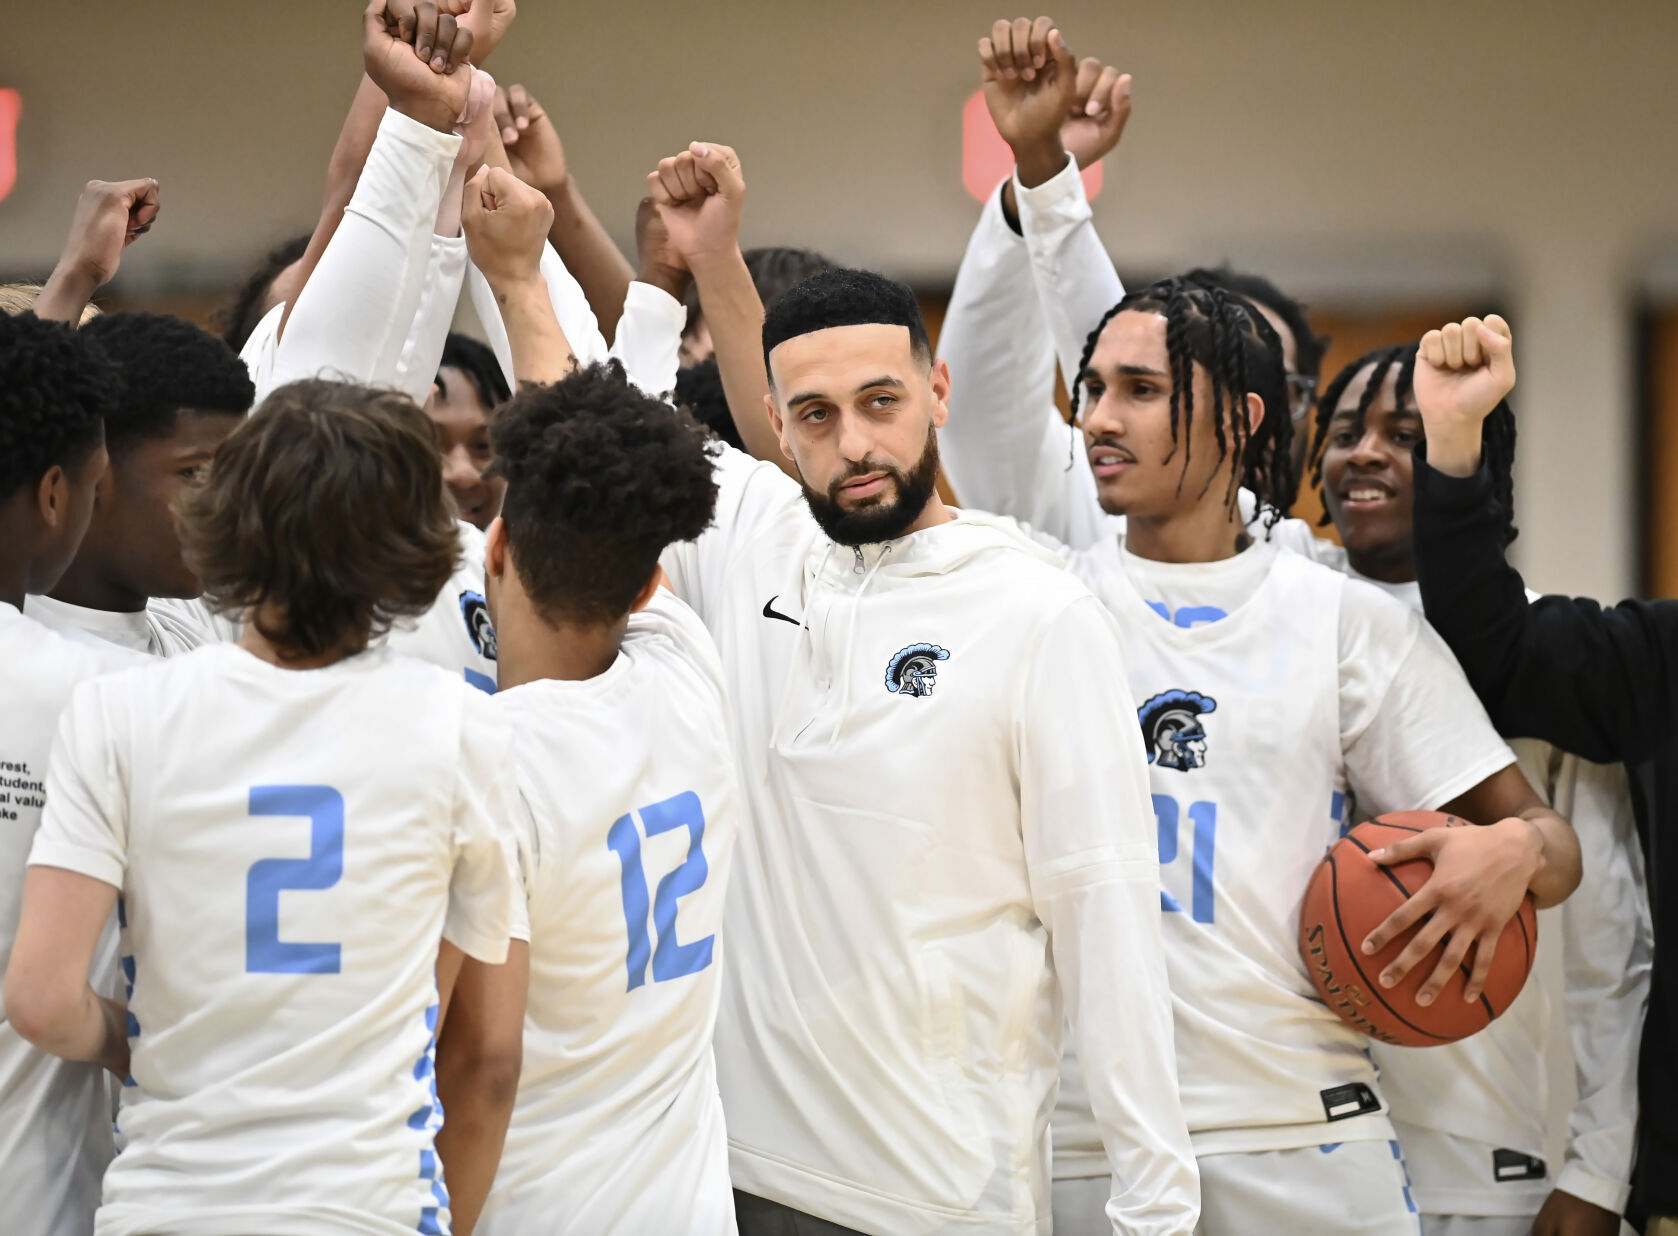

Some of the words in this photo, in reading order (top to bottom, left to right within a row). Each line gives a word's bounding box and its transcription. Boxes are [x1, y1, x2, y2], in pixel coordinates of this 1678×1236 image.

[0, 808, 17, 820] ke
[246, 785, 344, 974] 2
[607, 790, 715, 993] 12
